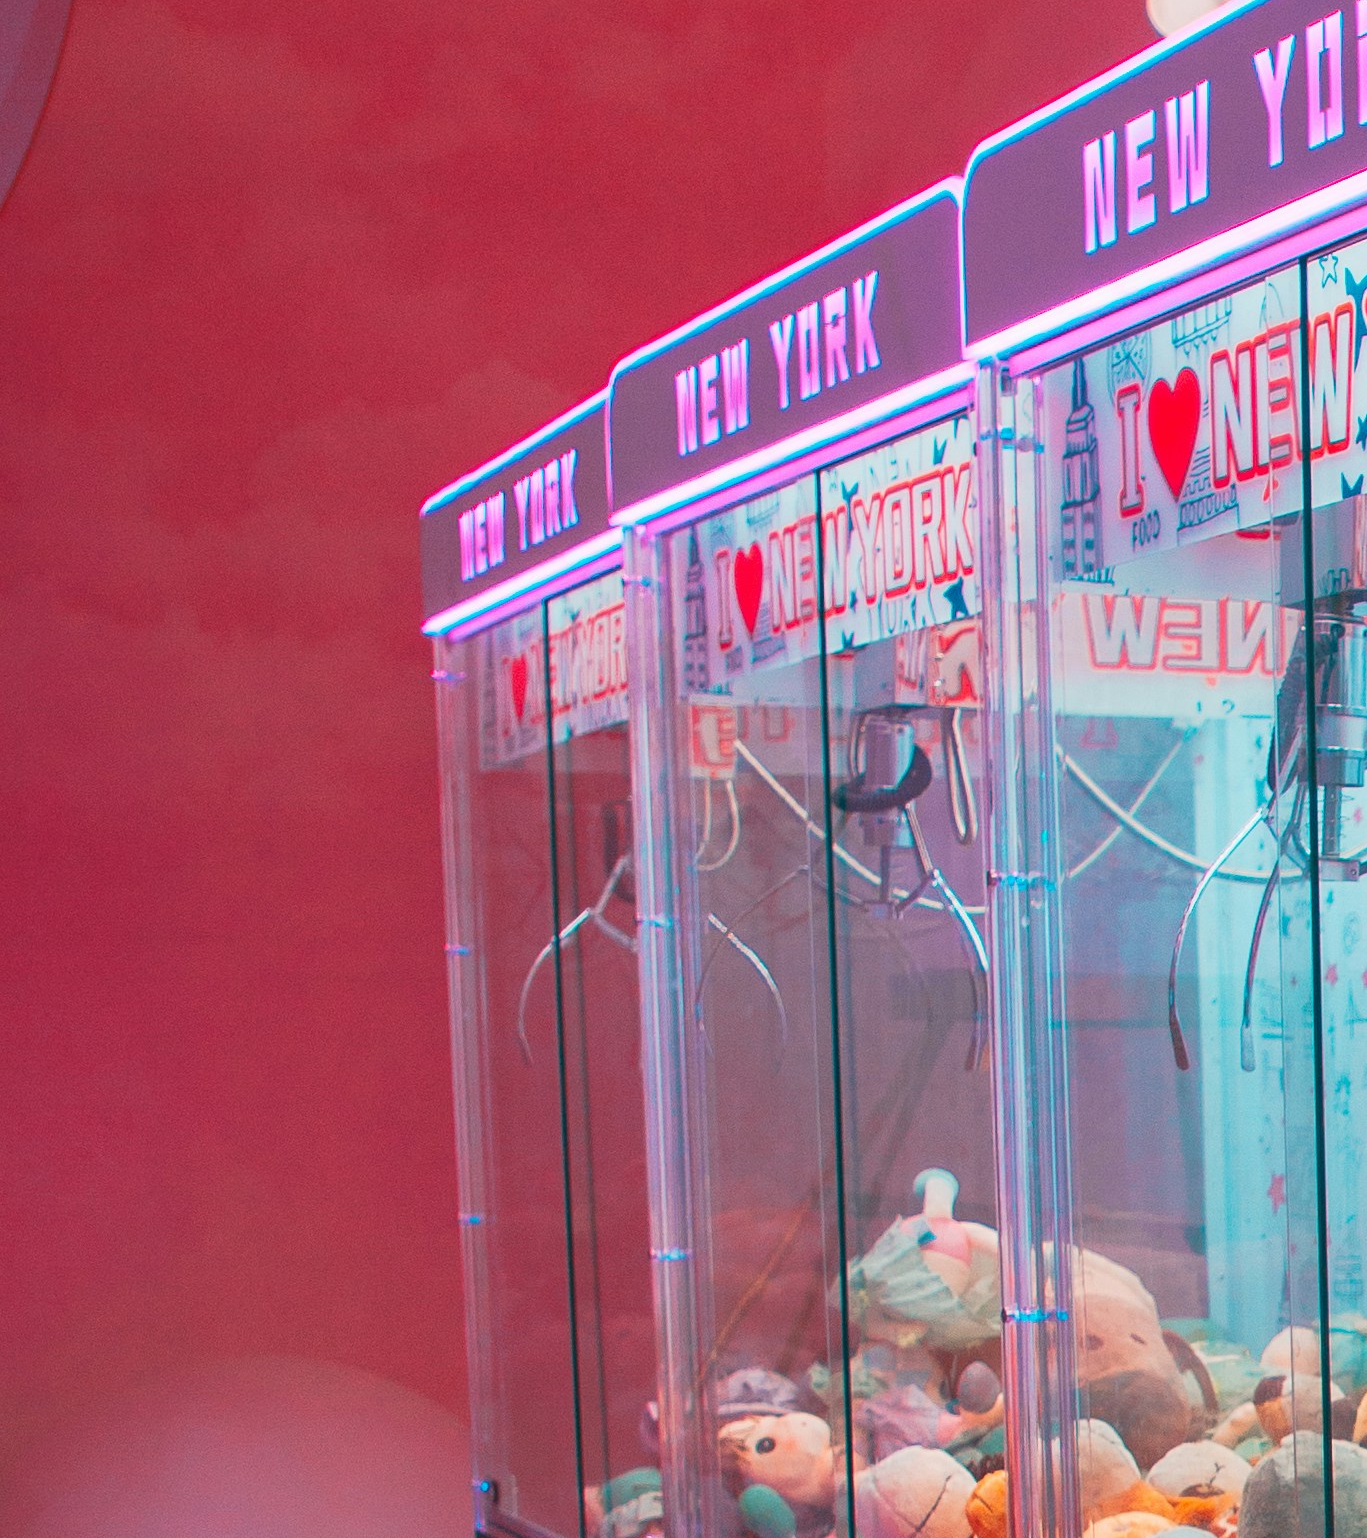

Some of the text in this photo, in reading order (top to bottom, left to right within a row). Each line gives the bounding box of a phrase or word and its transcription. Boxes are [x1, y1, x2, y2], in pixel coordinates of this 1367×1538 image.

[1082, 80, 1211, 256] NEW
[675, 270, 880, 457] NEW YORK
[1114, 380, 1147, 518] I
[1209, 302, 1356, 494] NEW
[457, 449, 579, 583] NEW YORK
[769, 505, 849, 635] NEW
[854, 461, 976, 605] YORK
